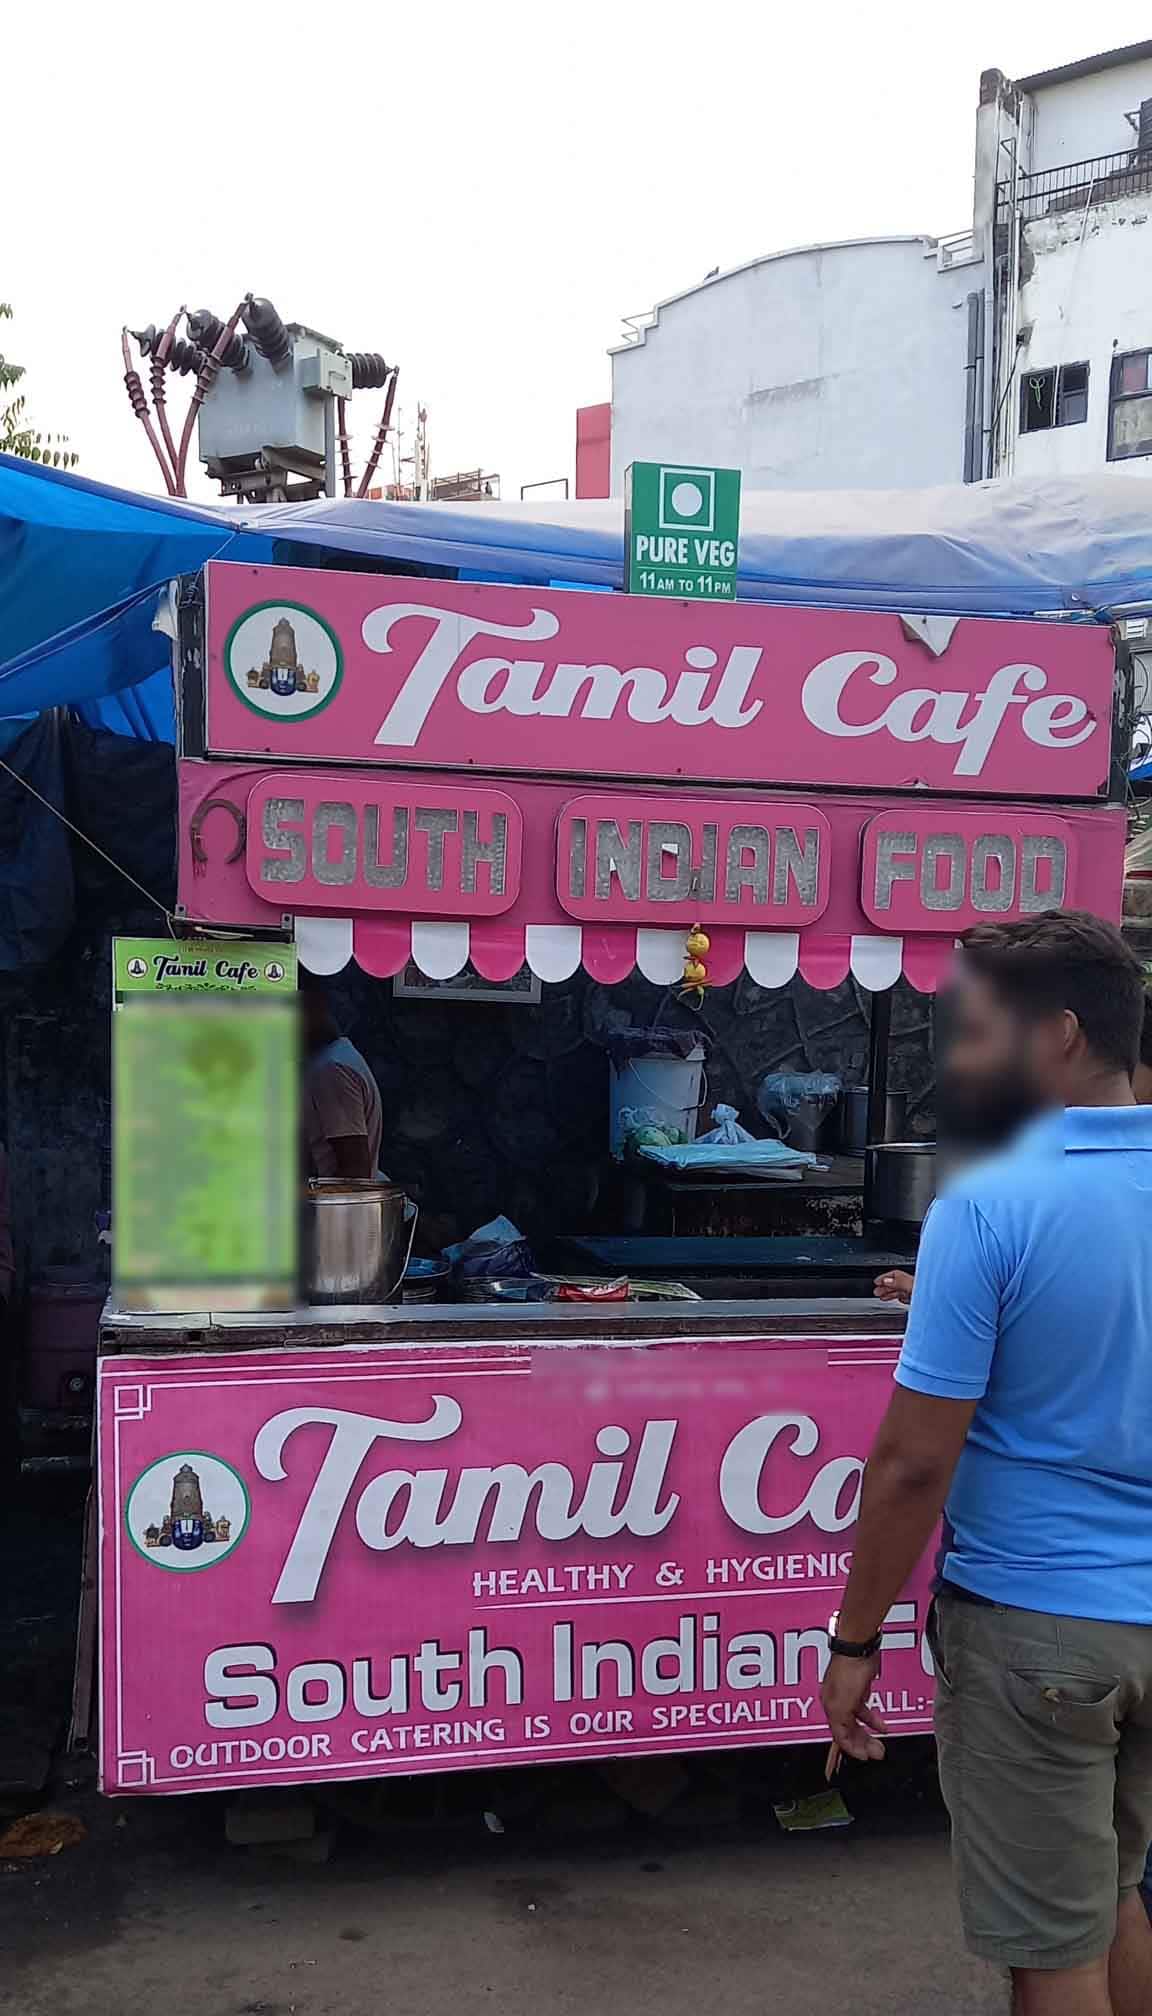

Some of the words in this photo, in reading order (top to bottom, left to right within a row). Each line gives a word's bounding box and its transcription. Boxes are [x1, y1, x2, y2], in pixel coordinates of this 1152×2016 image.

[636, 535, 689, 564] PURE
[694, 539, 735, 567] VEG
[678, 579, 693, 591] TO
[361, 603, 764, 747] Tamil
[801, 650, 1098, 776] Cafe
[261, 798, 508, 896] SOUTH
[569, 816, 820, 906] INDIAN
[873, 830, 1066, 912] FOOD
[153, 955, 207, 981] Tamil
[215, 960, 258, 984] Cafe
[253, 1394, 681, 1604] Tamil
[719, 1415, 868, 1534] Ca
[472, 1564, 634, 1597] HEALTHY
[655, 1561, 684, 1587] &
[203, 1627, 523, 1729] South
[553, 1611, 832, 1702] Indian
[169, 1733, 331, 1769] OUTDOOR
[351, 1718, 506, 1753] CATERING
[525, 1715, 551, 1739] IS
[570, 1710, 634, 1735] OUR
[652, 1696, 814, 1730] SPECIALITY
